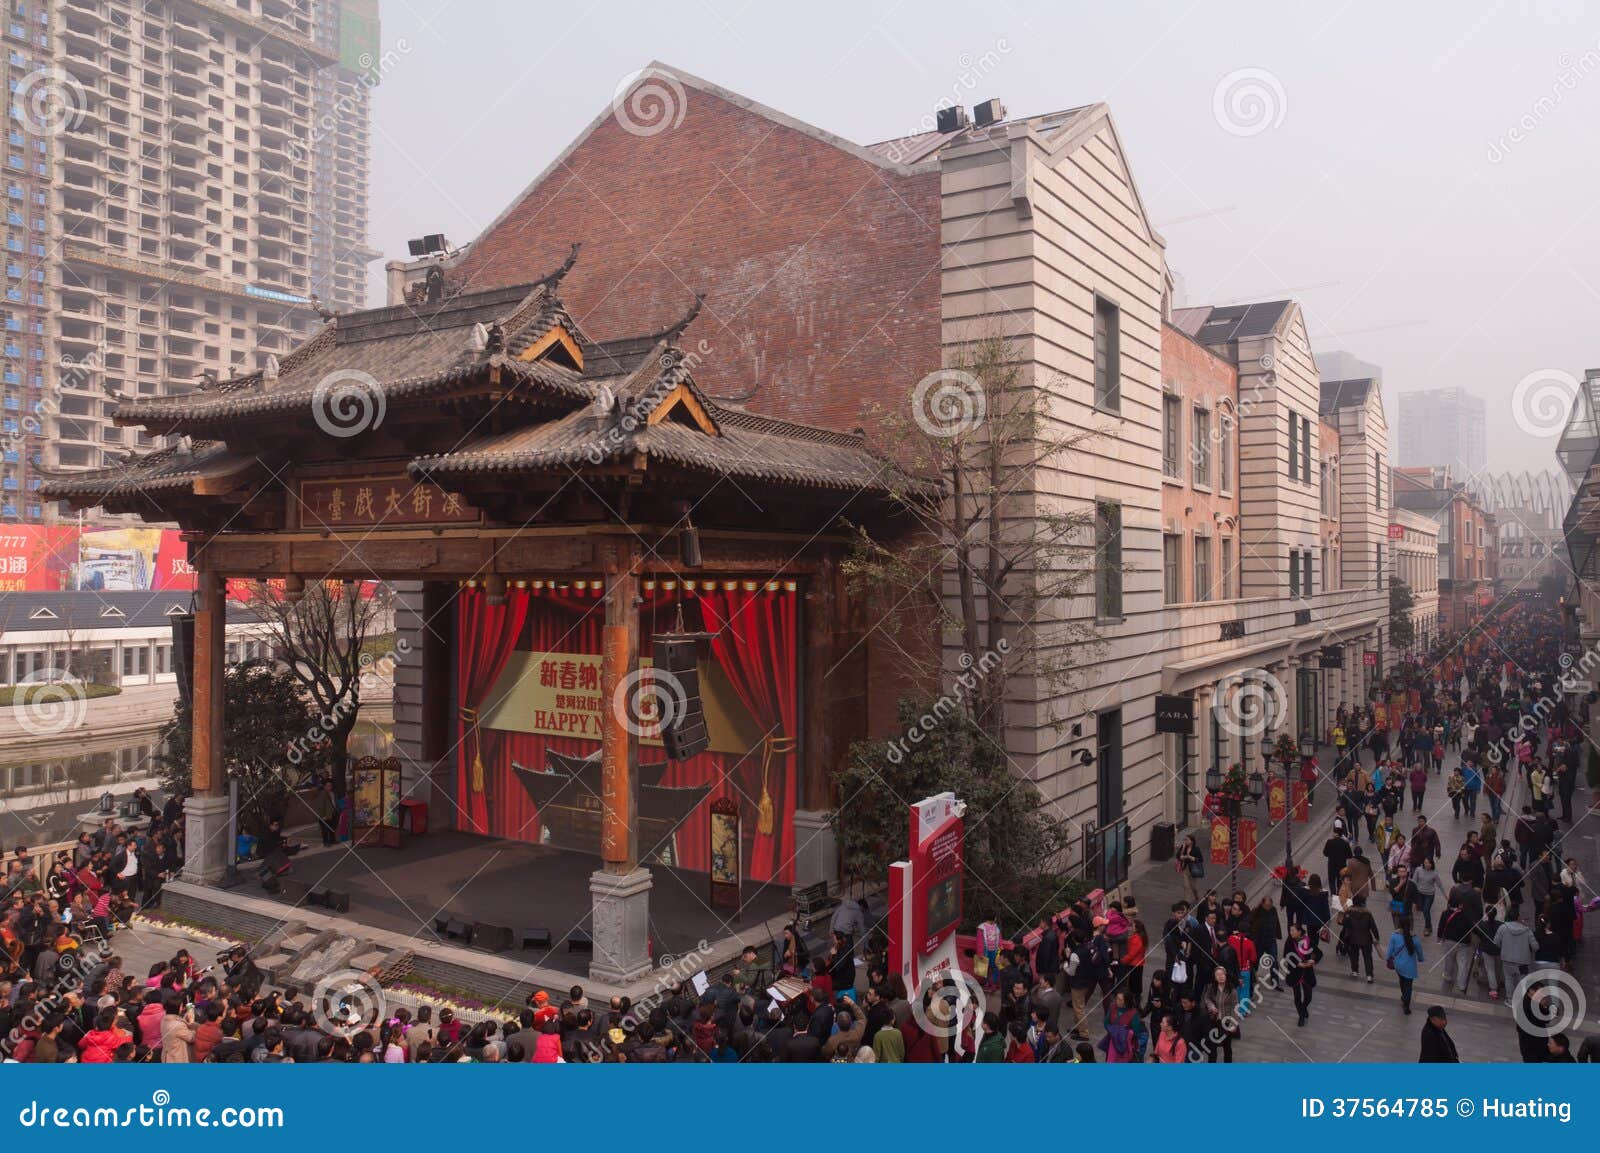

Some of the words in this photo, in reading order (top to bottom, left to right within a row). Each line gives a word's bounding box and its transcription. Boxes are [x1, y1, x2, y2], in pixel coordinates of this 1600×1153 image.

[0, 536, 27, 548] 777
[540, 660, 603, 690] 新春纳
[556, 694, 603, 711] 楚河汉街
[534, 709, 590, 734] HAPPY
[1160, 711, 1189, 719] ZARA
